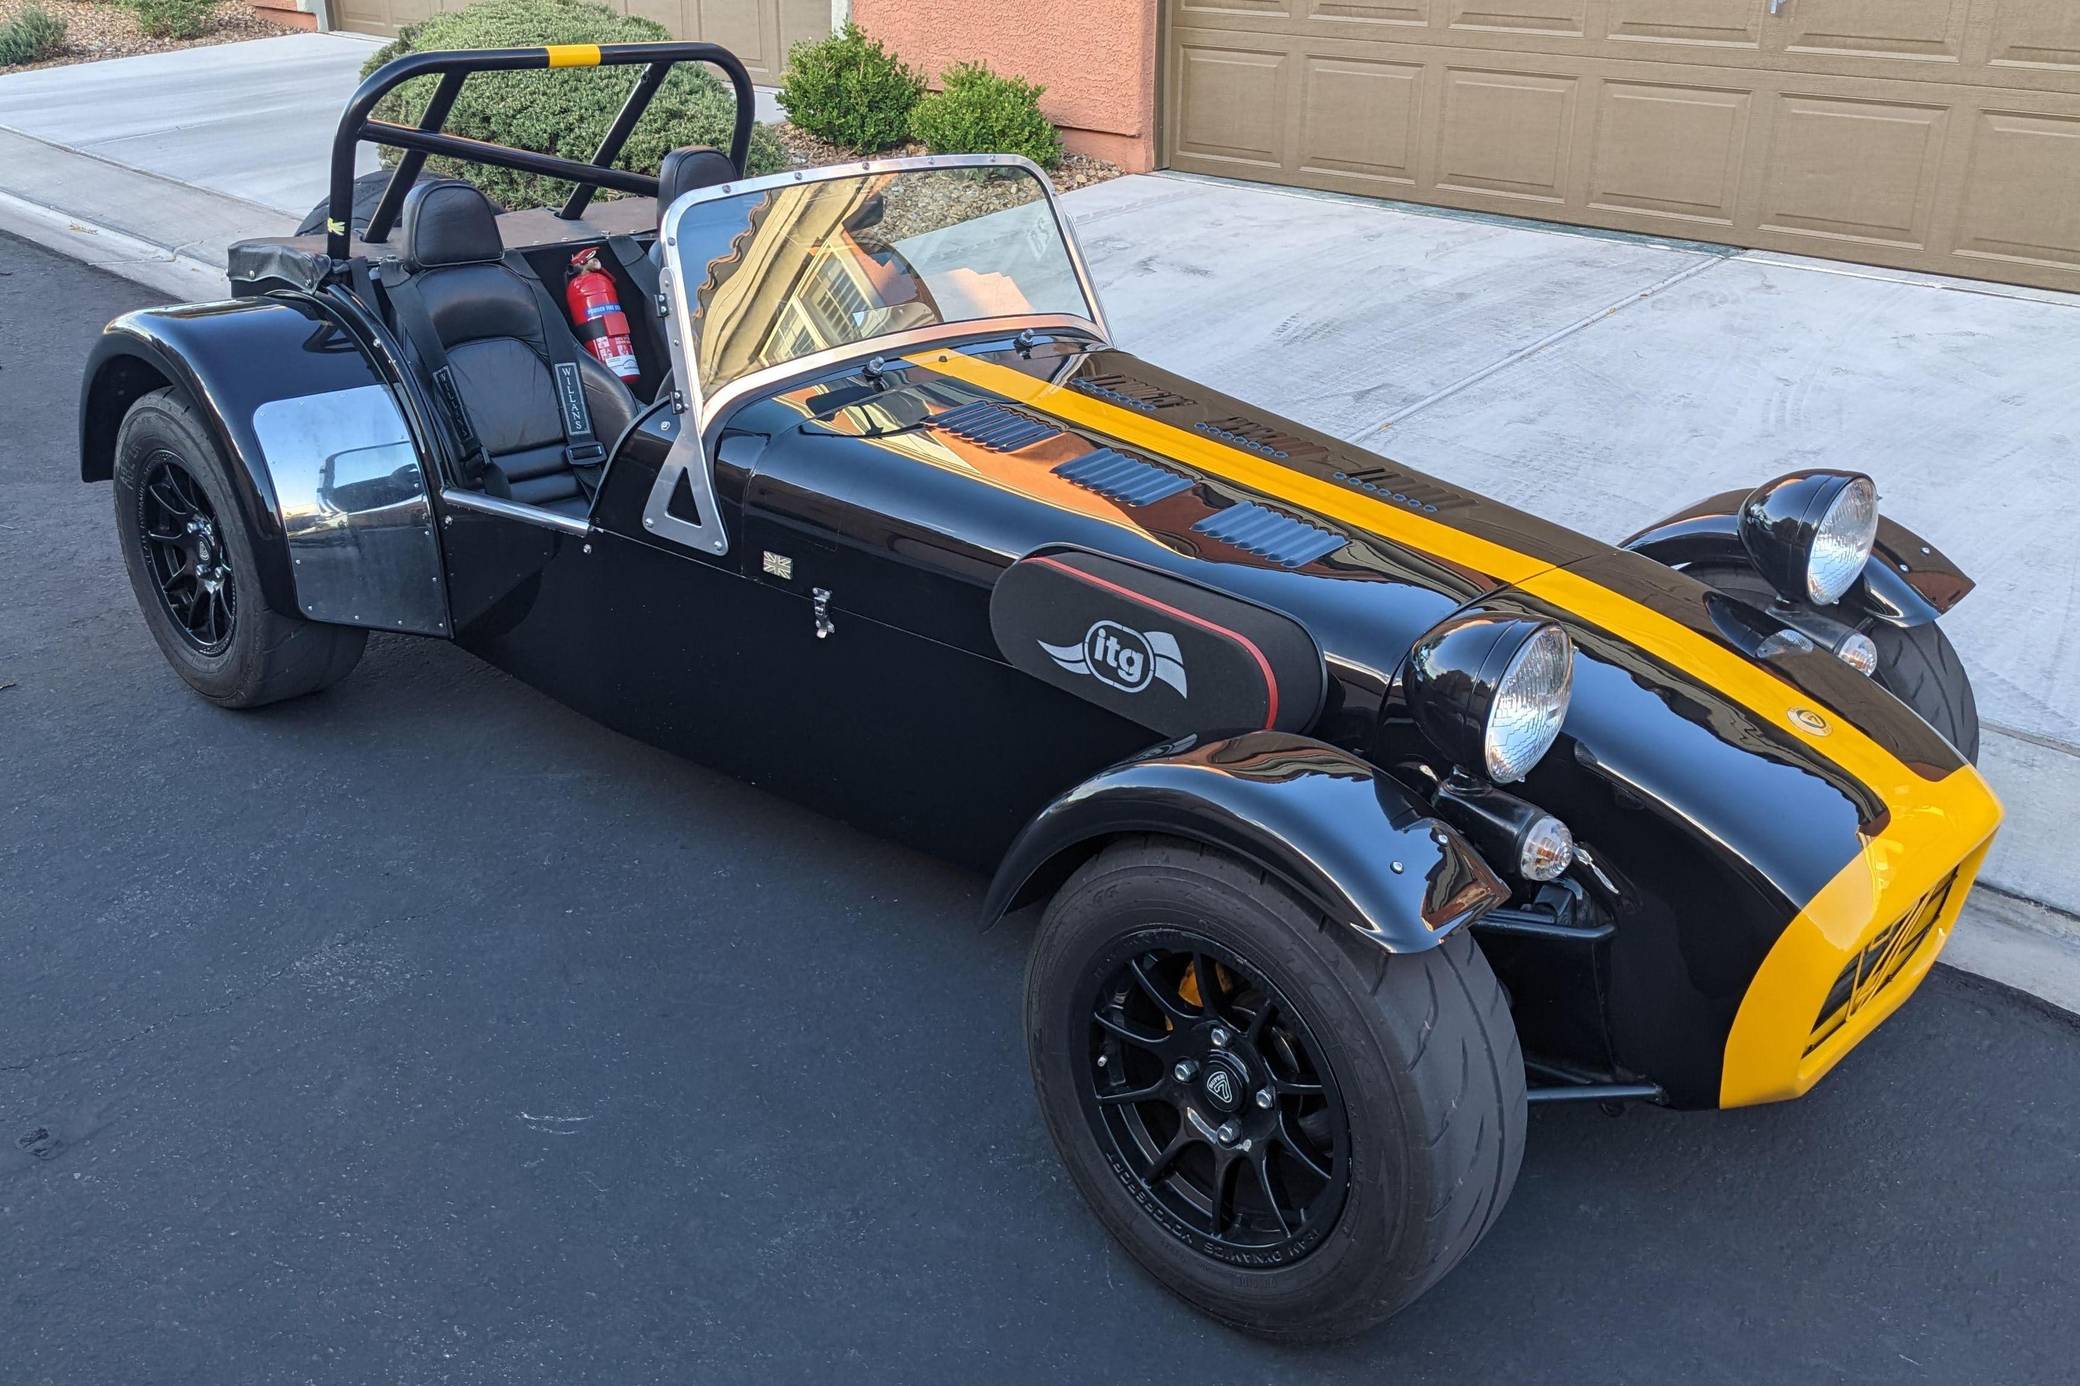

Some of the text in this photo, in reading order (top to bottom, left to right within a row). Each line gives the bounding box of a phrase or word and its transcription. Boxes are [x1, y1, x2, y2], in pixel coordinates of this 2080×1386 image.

[562, 367, 582, 430] WILLANS
[1093, 628, 1143, 682] itg
[1209, 1073, 1226, 1089] SUPER
[1213, 1079, 1229, 1100] 7
